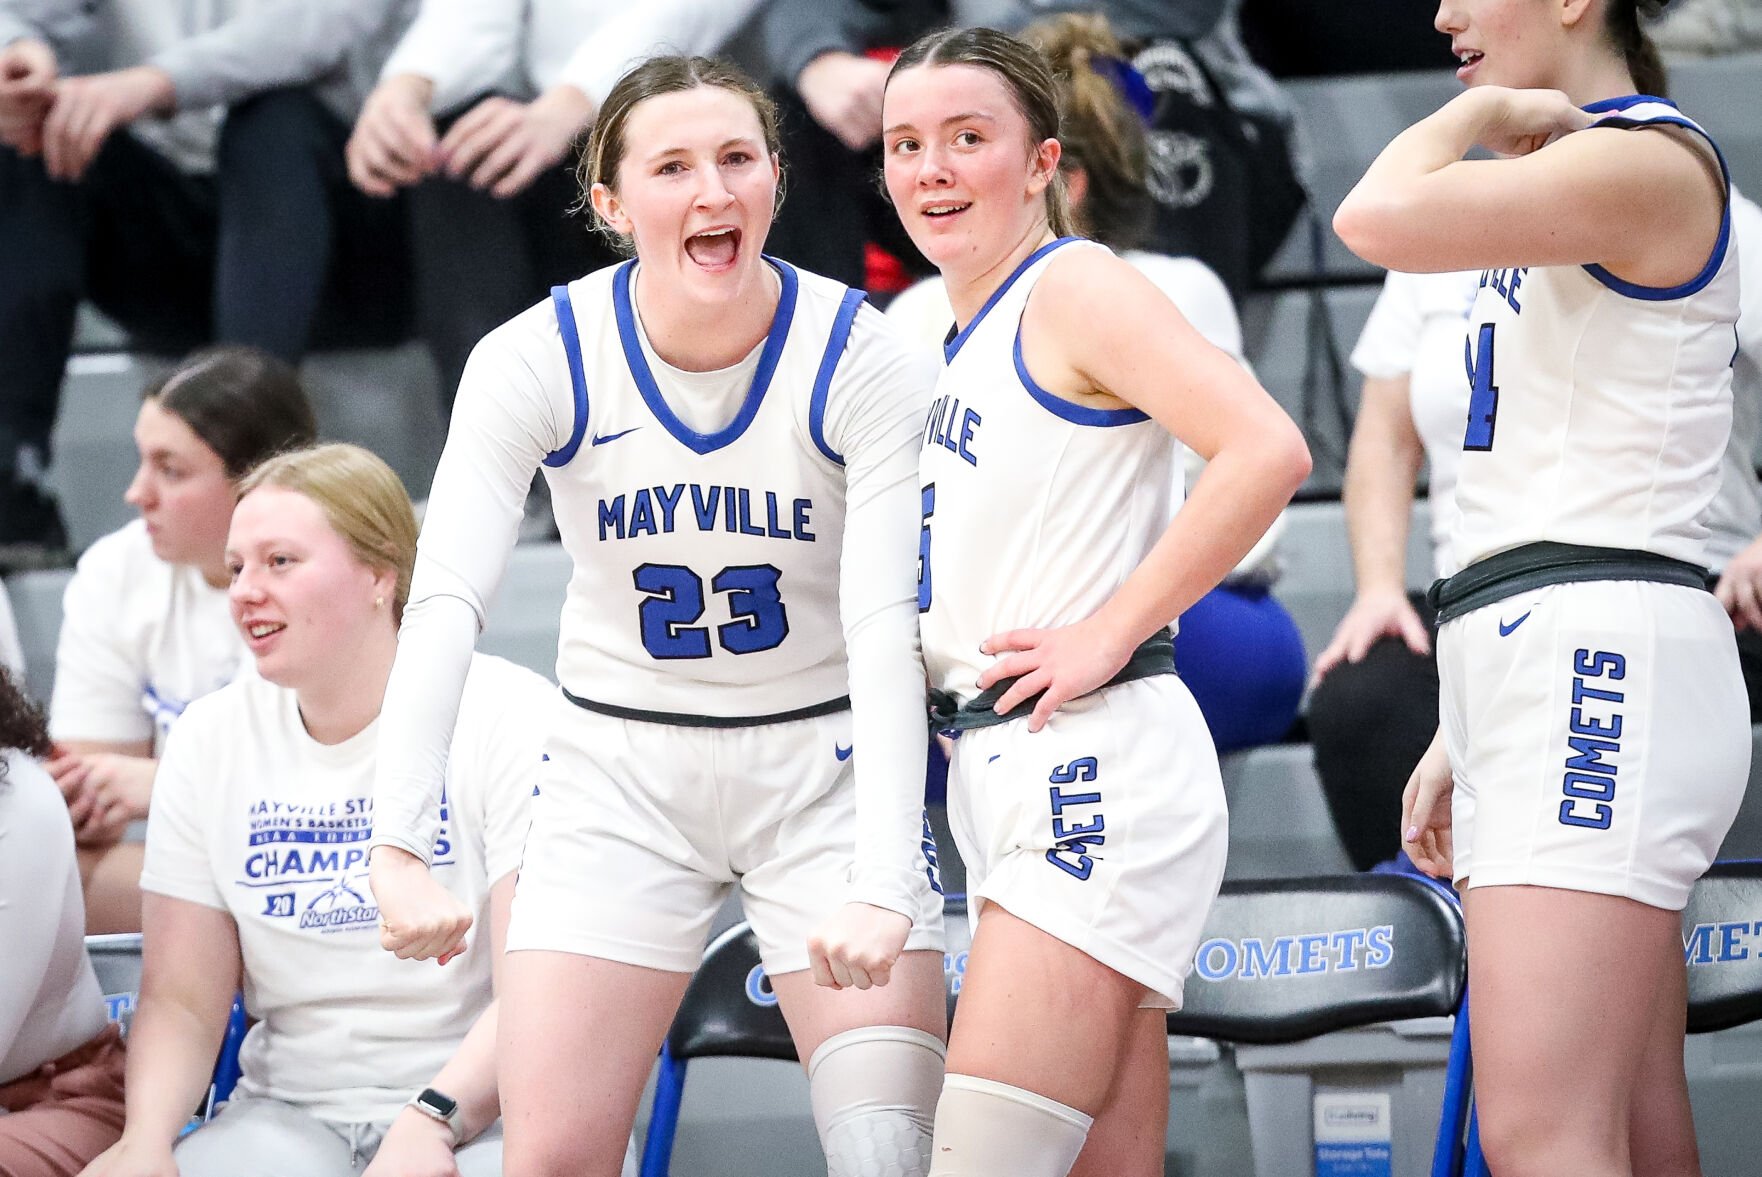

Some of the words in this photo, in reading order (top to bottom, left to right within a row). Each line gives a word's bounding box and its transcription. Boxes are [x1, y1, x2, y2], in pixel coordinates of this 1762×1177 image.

[597, 483, 816, 543] MAYVILLE
[632, 562, 790, 660] 23
[1558, 648, 1626, 830] COMETS
[1045, 756, 1106, 881] CMETS
[1187, 925, 1394, 982] OMETS
